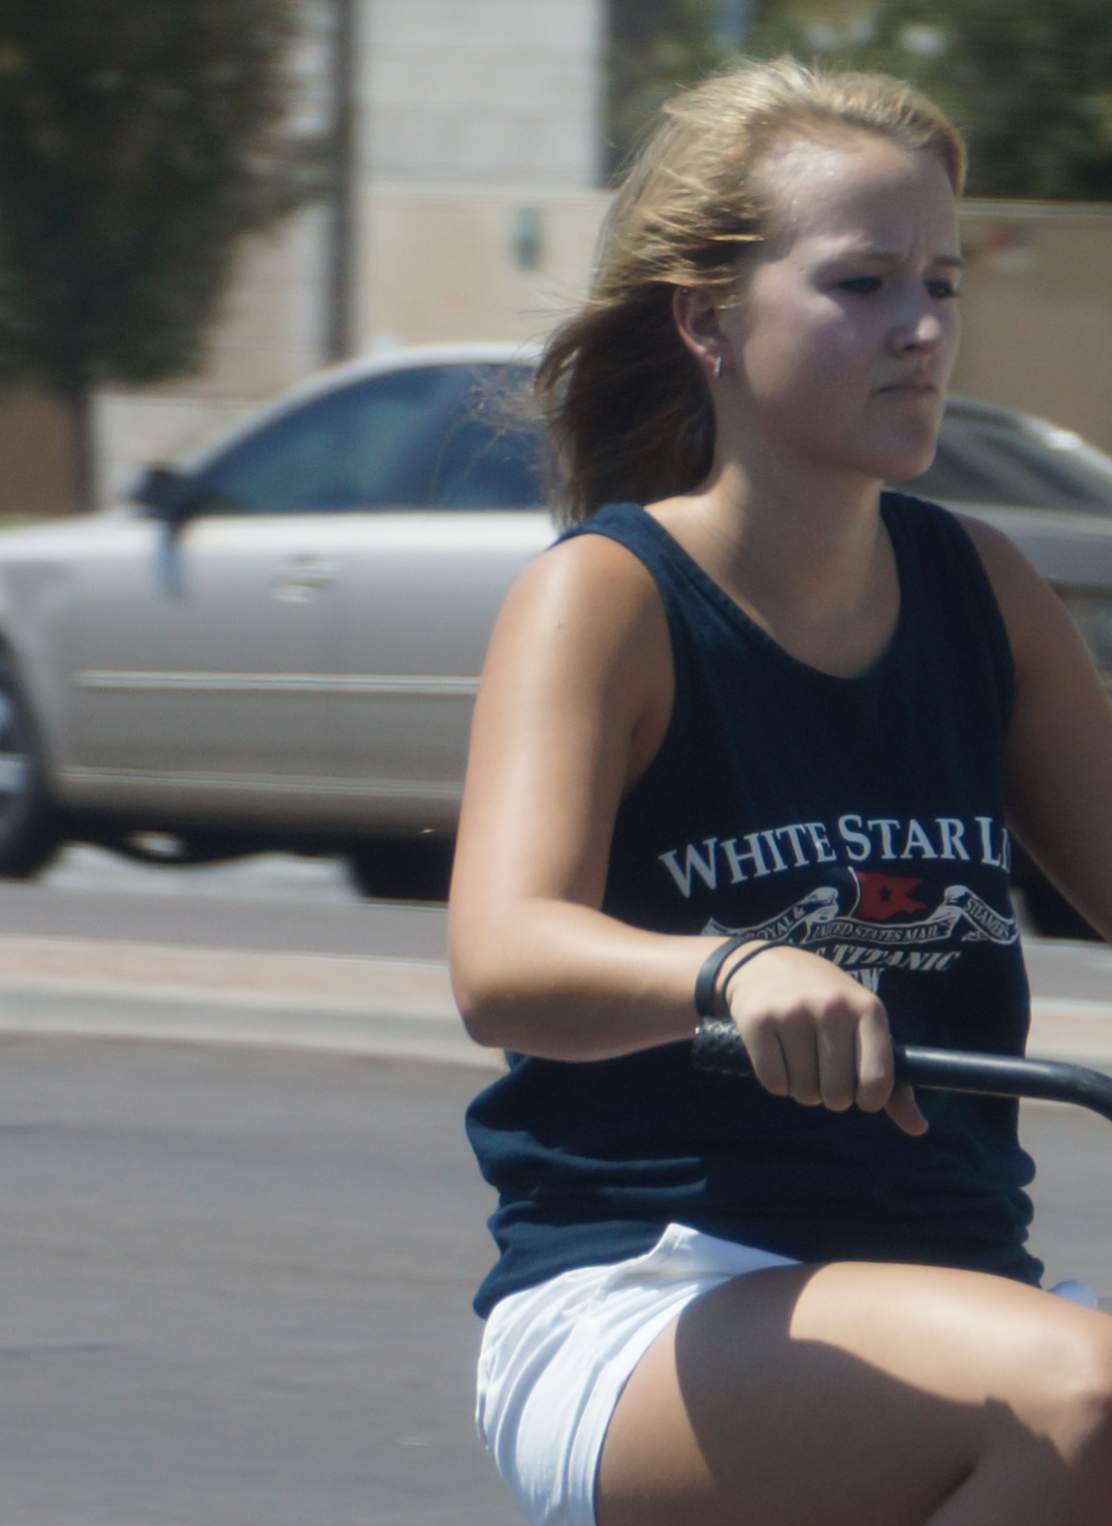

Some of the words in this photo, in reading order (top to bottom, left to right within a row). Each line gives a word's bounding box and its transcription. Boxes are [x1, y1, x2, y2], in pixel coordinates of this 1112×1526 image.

[659, 821, 836, 899] WHITE
[838, 814, 968, 862] STAR
[829, 943, 962, 972] TITANIC
